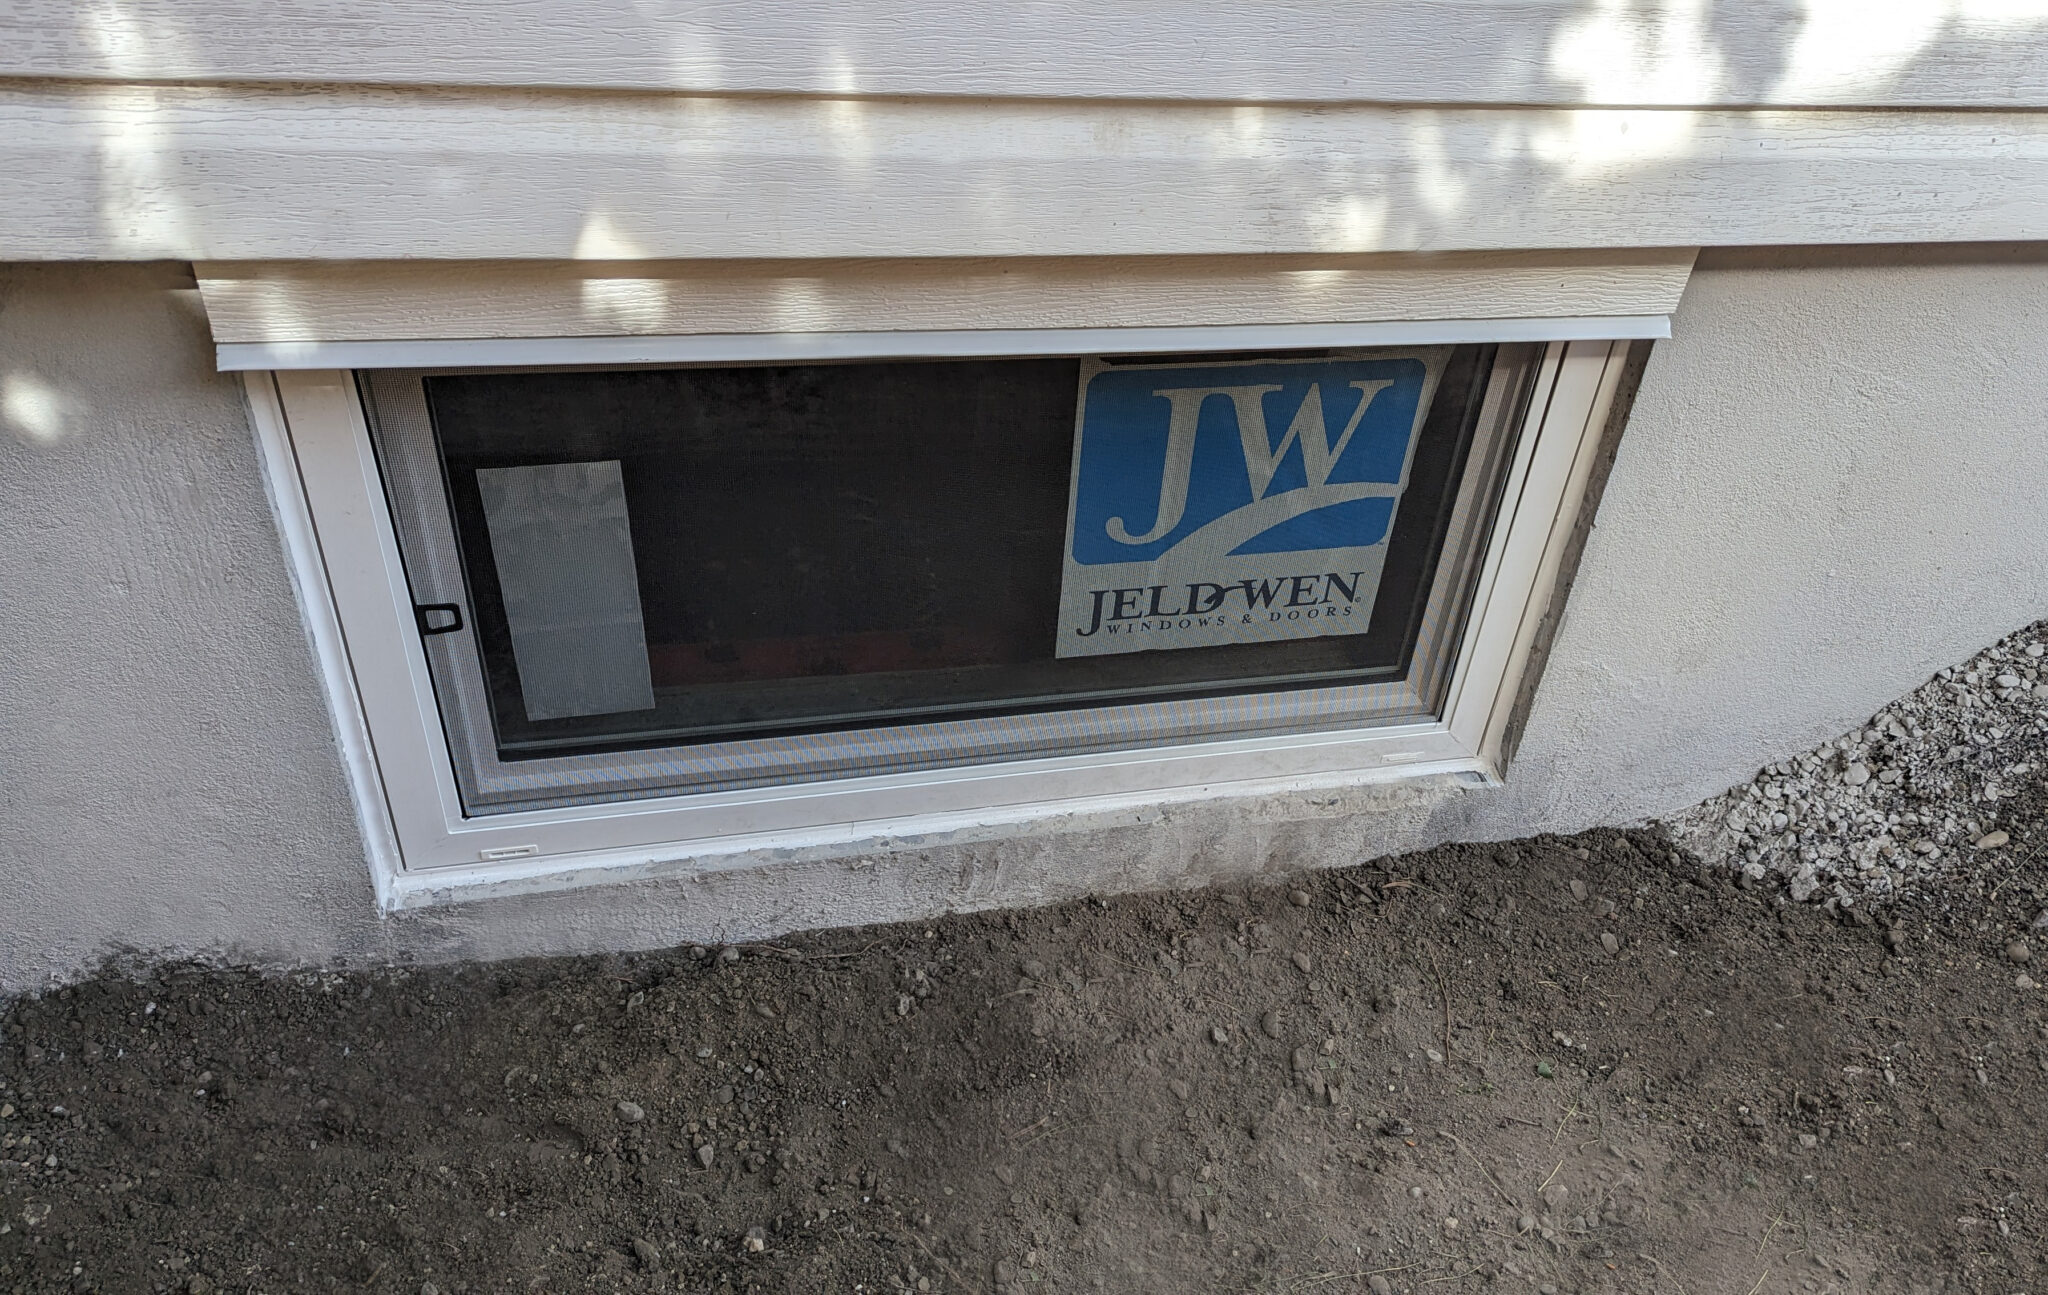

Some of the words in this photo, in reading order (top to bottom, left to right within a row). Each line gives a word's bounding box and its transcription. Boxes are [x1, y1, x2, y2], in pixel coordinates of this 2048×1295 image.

[1105, 379, 1395, 545] JW
[1107, 615, 1225, 635] WINDOWS
[1241, 613, 1253, 624] &
[1269, 605, 1352, 622] DOORS
